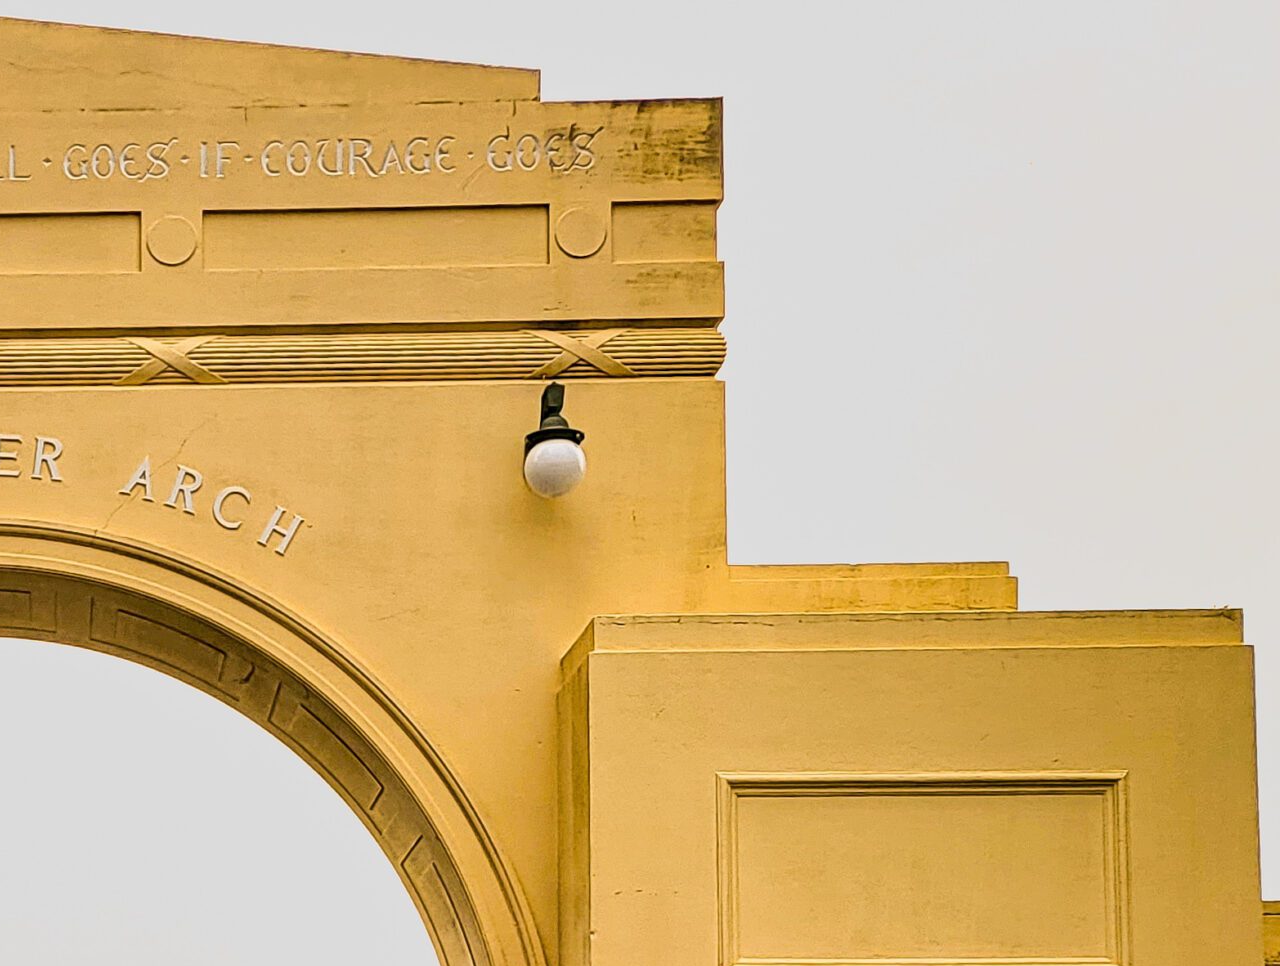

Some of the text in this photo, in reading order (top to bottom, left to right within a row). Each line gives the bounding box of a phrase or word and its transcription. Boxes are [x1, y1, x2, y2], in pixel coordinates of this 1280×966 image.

[62, 137, 178, 183] GOES
[199, 140, 241, 178] IF
[260, 135, 457, 178] COURAGE
[486, 126, 604, 175] GOES
[119, 455, 306, 557] ARCH
